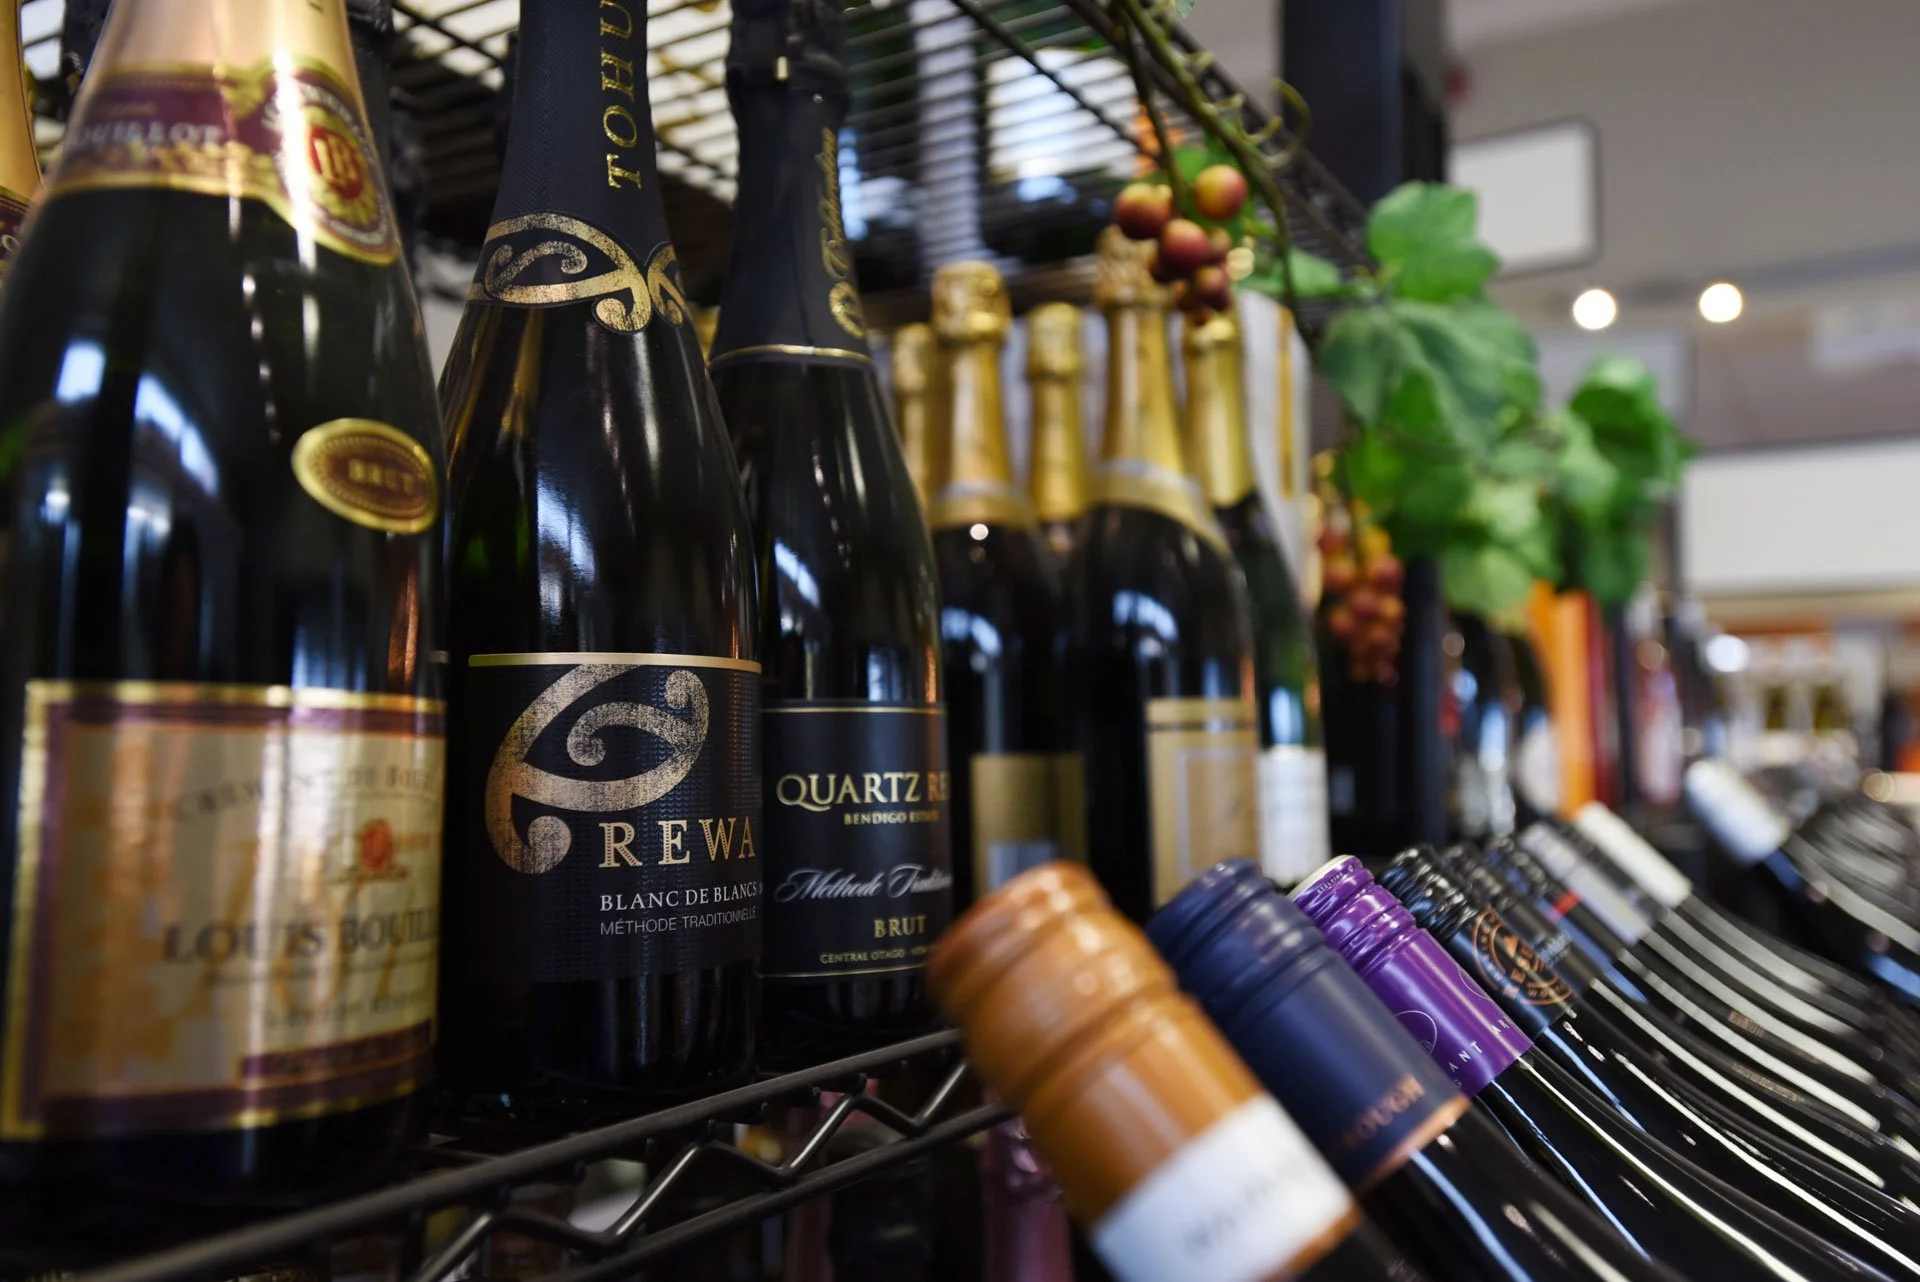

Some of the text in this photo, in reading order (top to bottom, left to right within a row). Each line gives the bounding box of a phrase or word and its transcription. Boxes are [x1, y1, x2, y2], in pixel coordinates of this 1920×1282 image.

[600, 0, 641, 189] TOHU
[349, 458, 414, 494] BRUT
[776, 771, 920, 812] QUARTZ
[843, 810, 906, 826] BENDIGO
[598, 815, 756, 868] REWA
[600, 890, 679, 912] BLANC
[685, 888, 709, 906] DE
[713, 880, 757, 904] BLANCS
[600, 904, 756, 936] MÉTHODE TRADITIONNELLE
[874, 916, 926, 938] BRUT
[820, 951, 868, 965] CENTRAL
[870, 948, 906, 961] OTAGO
